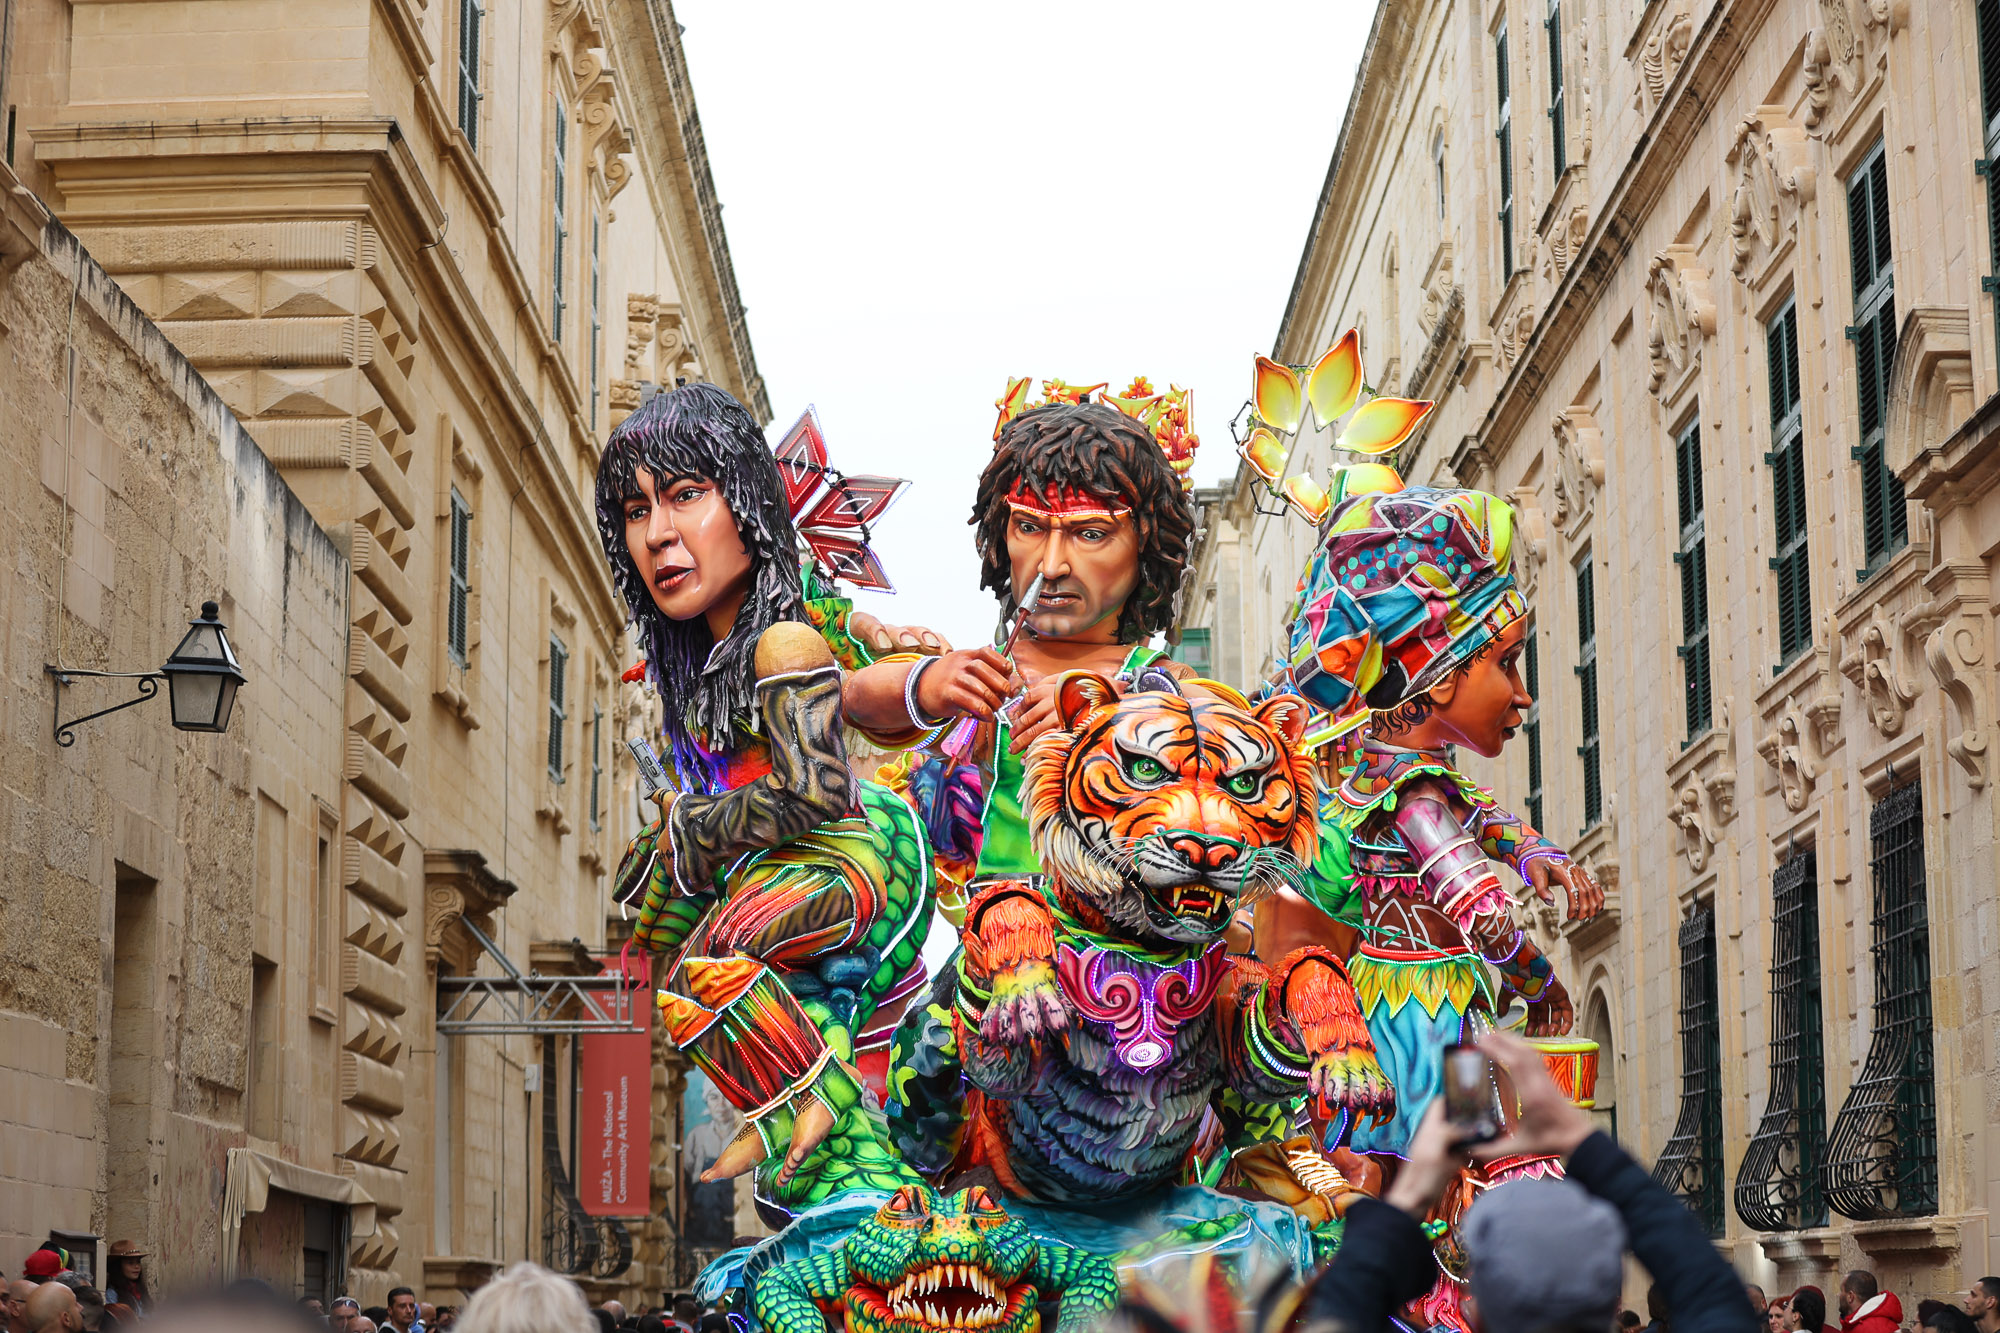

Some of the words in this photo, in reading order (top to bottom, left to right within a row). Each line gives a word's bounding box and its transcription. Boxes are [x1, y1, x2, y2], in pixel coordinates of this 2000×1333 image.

[603, 1091, 614, 1137] National
[618, 1076, 628, 1121] Museum
[602, 1140, 613, 1158] The
[618, 1123, 628, 1140] Art
[600, 1170, 612, 1204] MUŻA
[616, 1143, 630, 1204] Community
